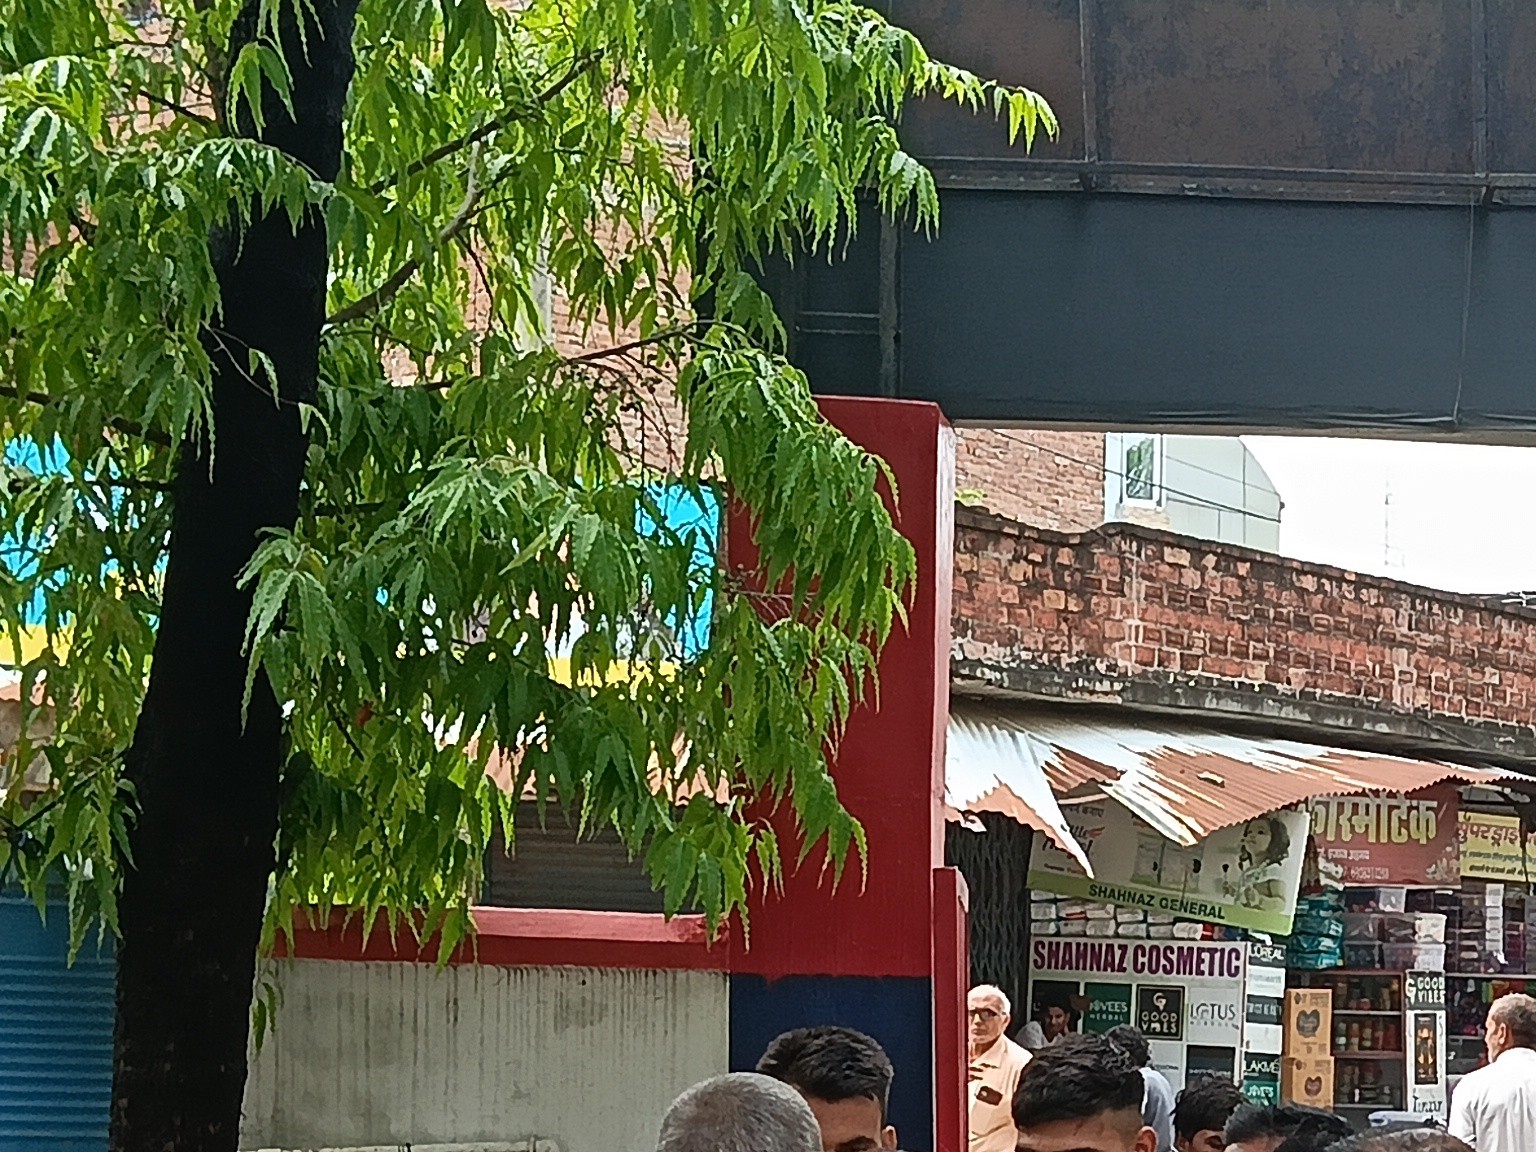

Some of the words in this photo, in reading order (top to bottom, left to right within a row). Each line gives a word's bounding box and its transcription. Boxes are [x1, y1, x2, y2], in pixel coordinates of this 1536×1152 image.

[1089, 884, 1155, 908] SHAHNAZ
[1159, 897, 1226, 920] GENERAL
[1033, 940, 1129, 974] SHAHNAZ
[1132, 944, 1241, 978] COSMETIC
[1141, 1011, 1177, 1022] GOOD
[1190, 1002, 1236, 1021] LOTUS
